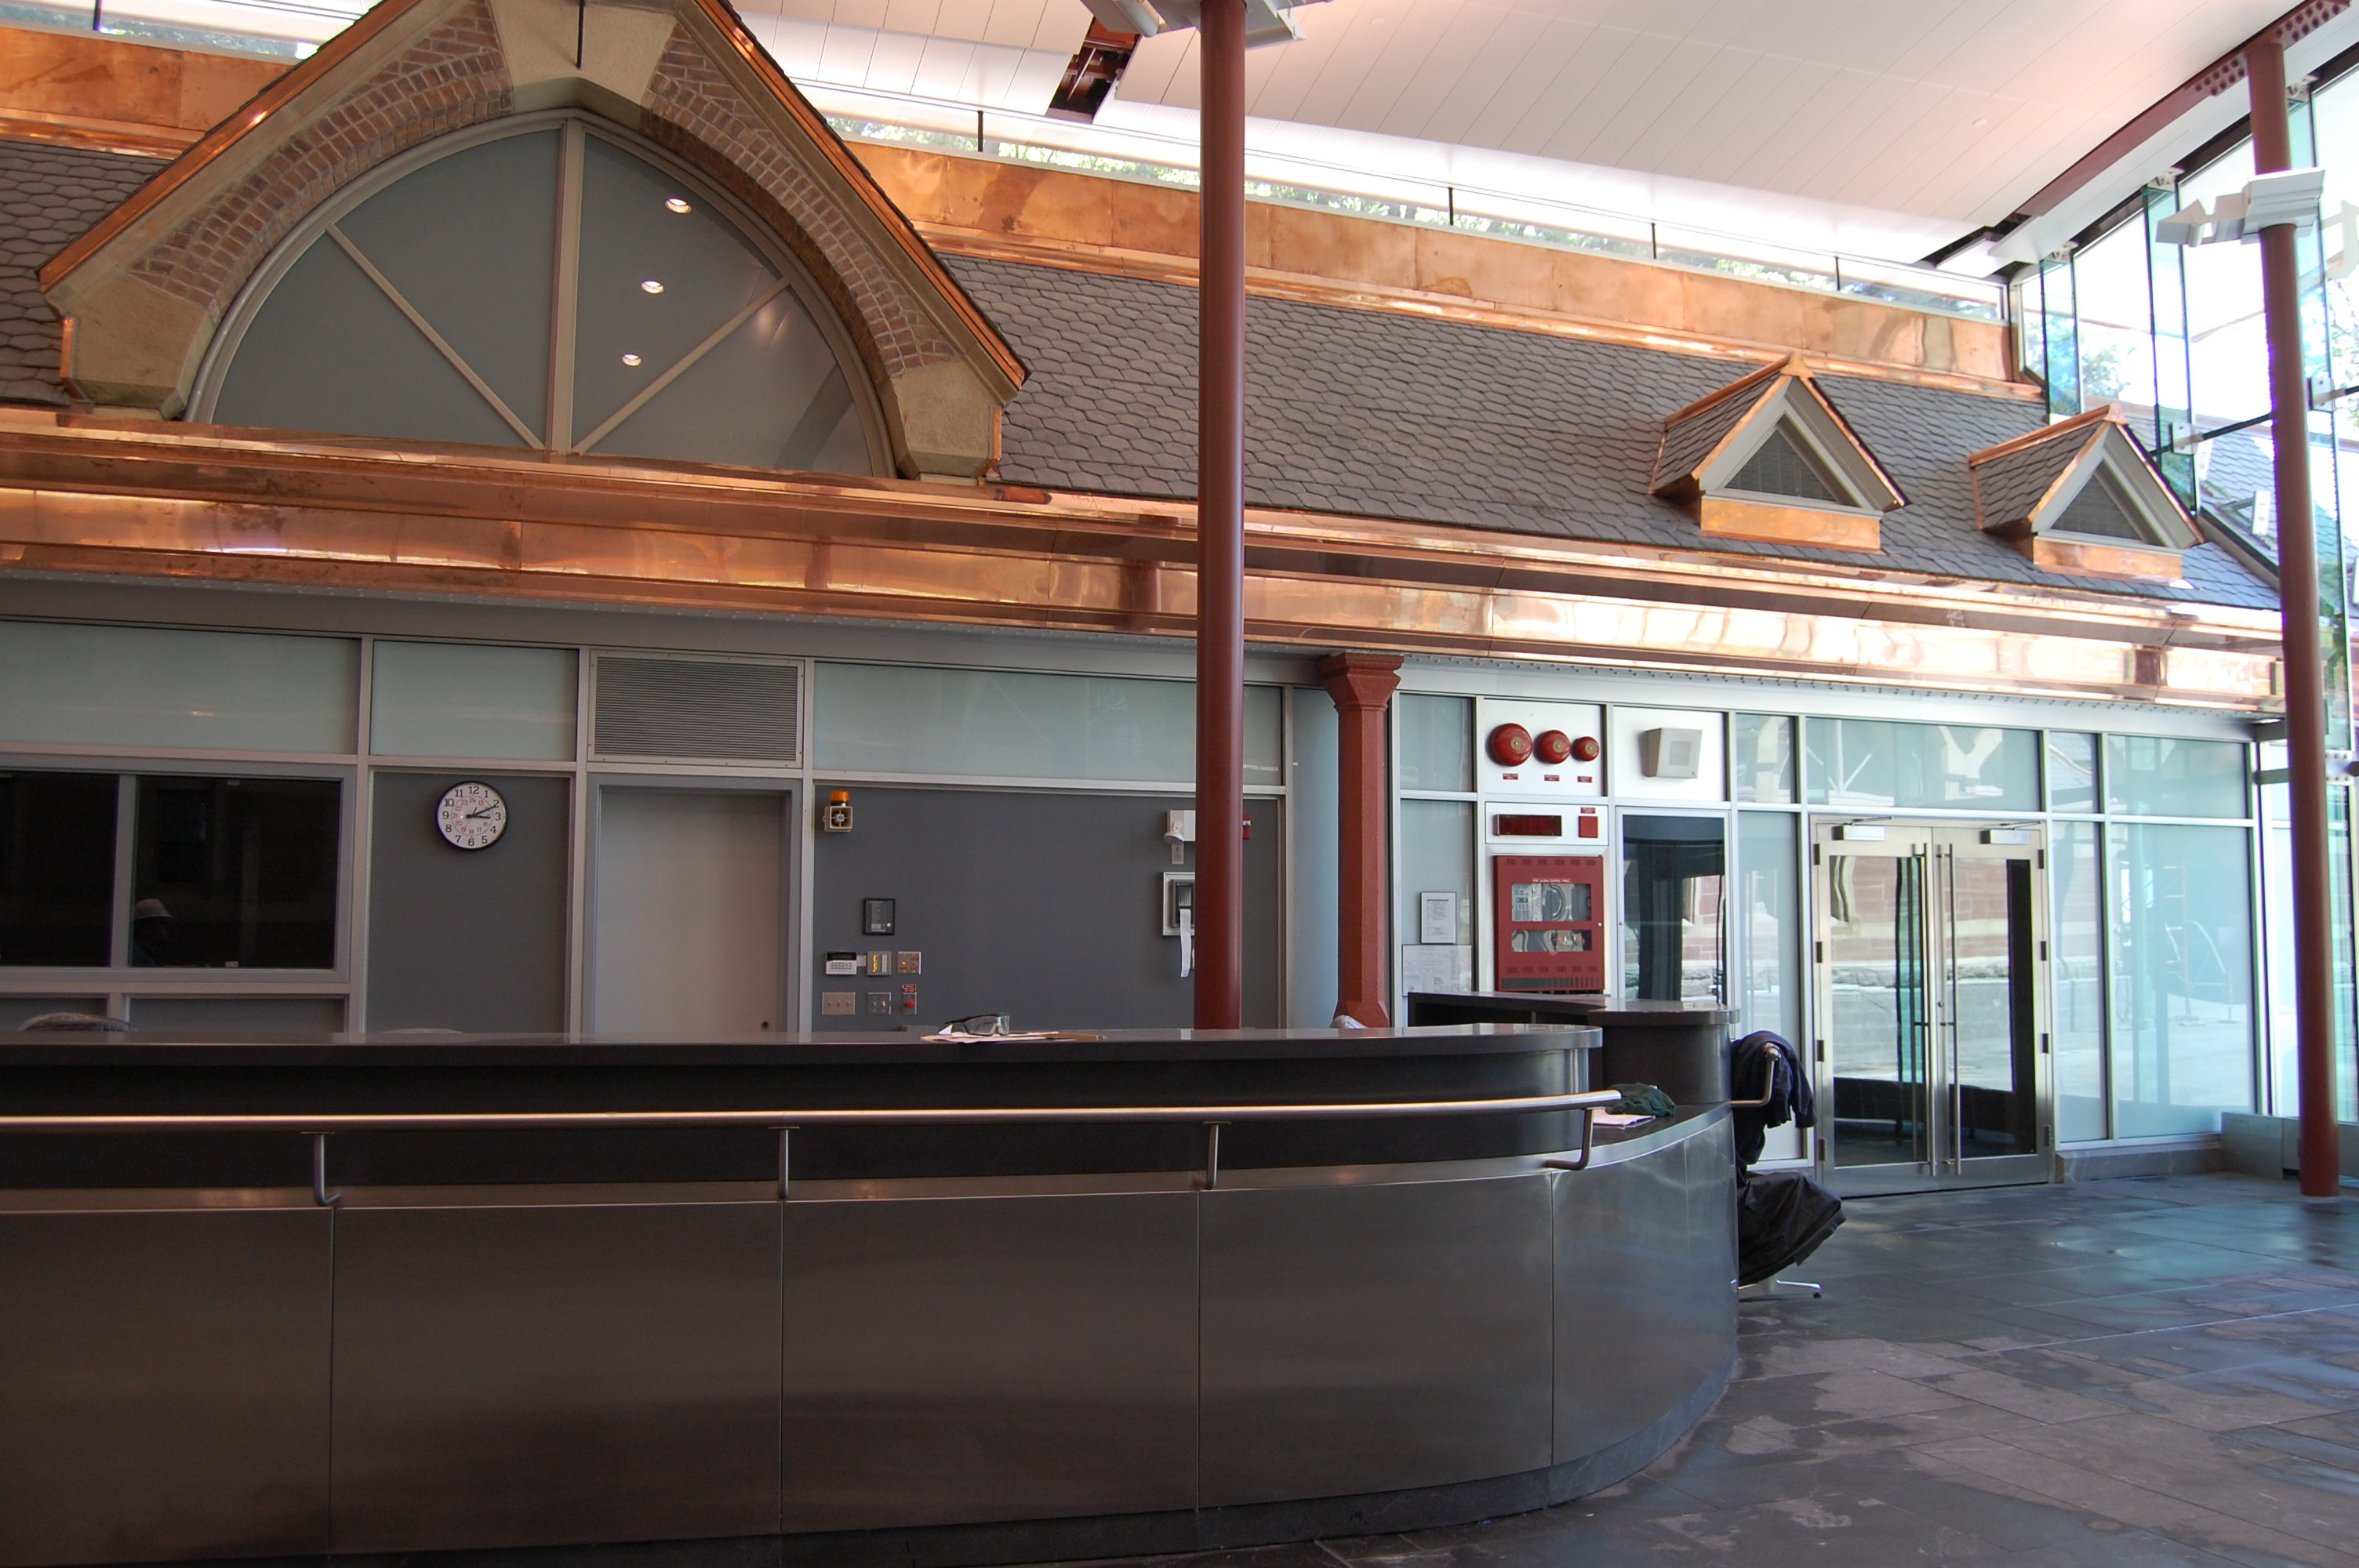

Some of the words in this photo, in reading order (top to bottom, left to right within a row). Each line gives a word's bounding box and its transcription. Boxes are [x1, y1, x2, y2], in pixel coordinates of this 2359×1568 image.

[455, 789, 463, 797] 11
[468, 786, 479, 794] 12
[445, 798, 455, 807] 10
[493, 800, 500, 808] 2
[442, 811, 449, 819] 9
[495, 812, 501, 821] 3
[445, 824, 453, 833] 8
[490, 826, 496, 834] 4
[455, 834, 462, 843] 7
[482, 835, 488, 844] 5
